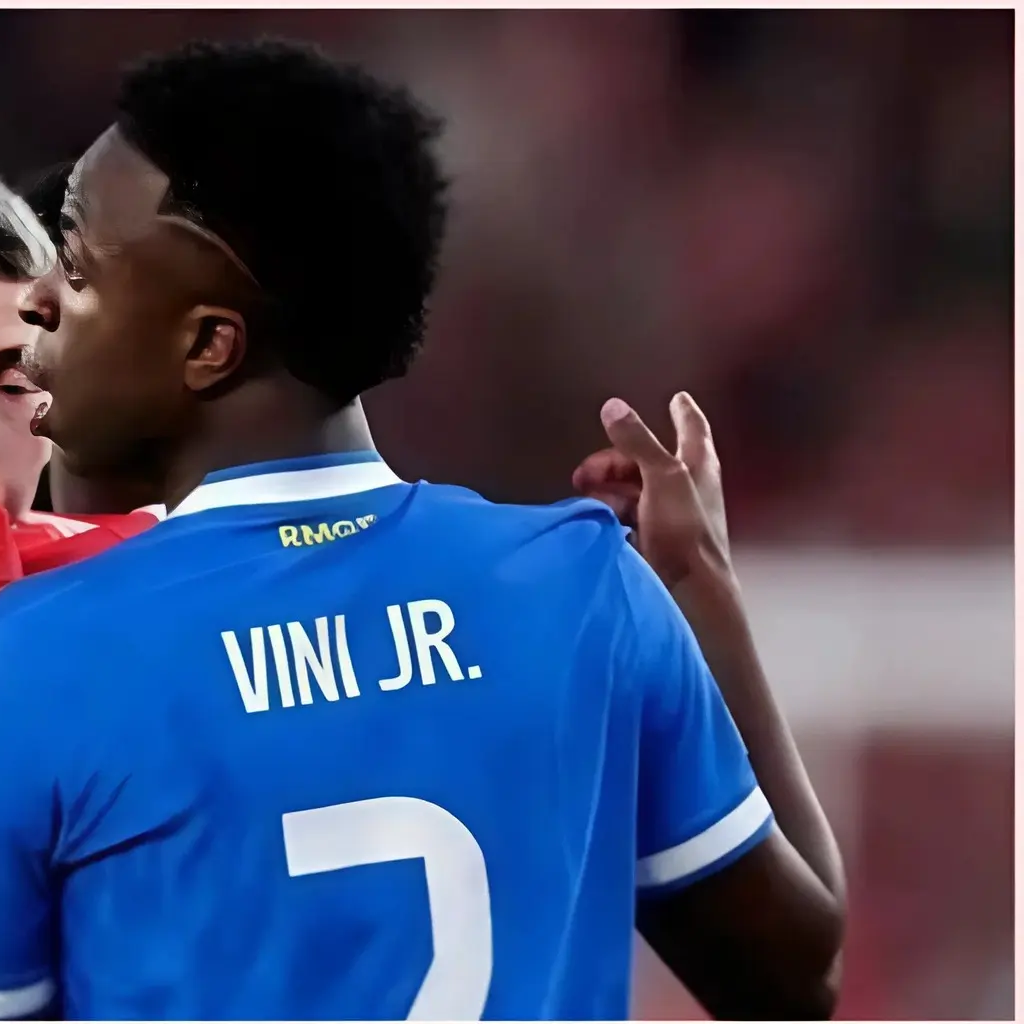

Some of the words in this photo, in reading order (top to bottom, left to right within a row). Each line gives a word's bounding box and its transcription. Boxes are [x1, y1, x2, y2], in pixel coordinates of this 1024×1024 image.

[221, 614, 360, 713] VINI
[378, 599, 482, 691] JR.
[282, 796, 493, 1021] 7
